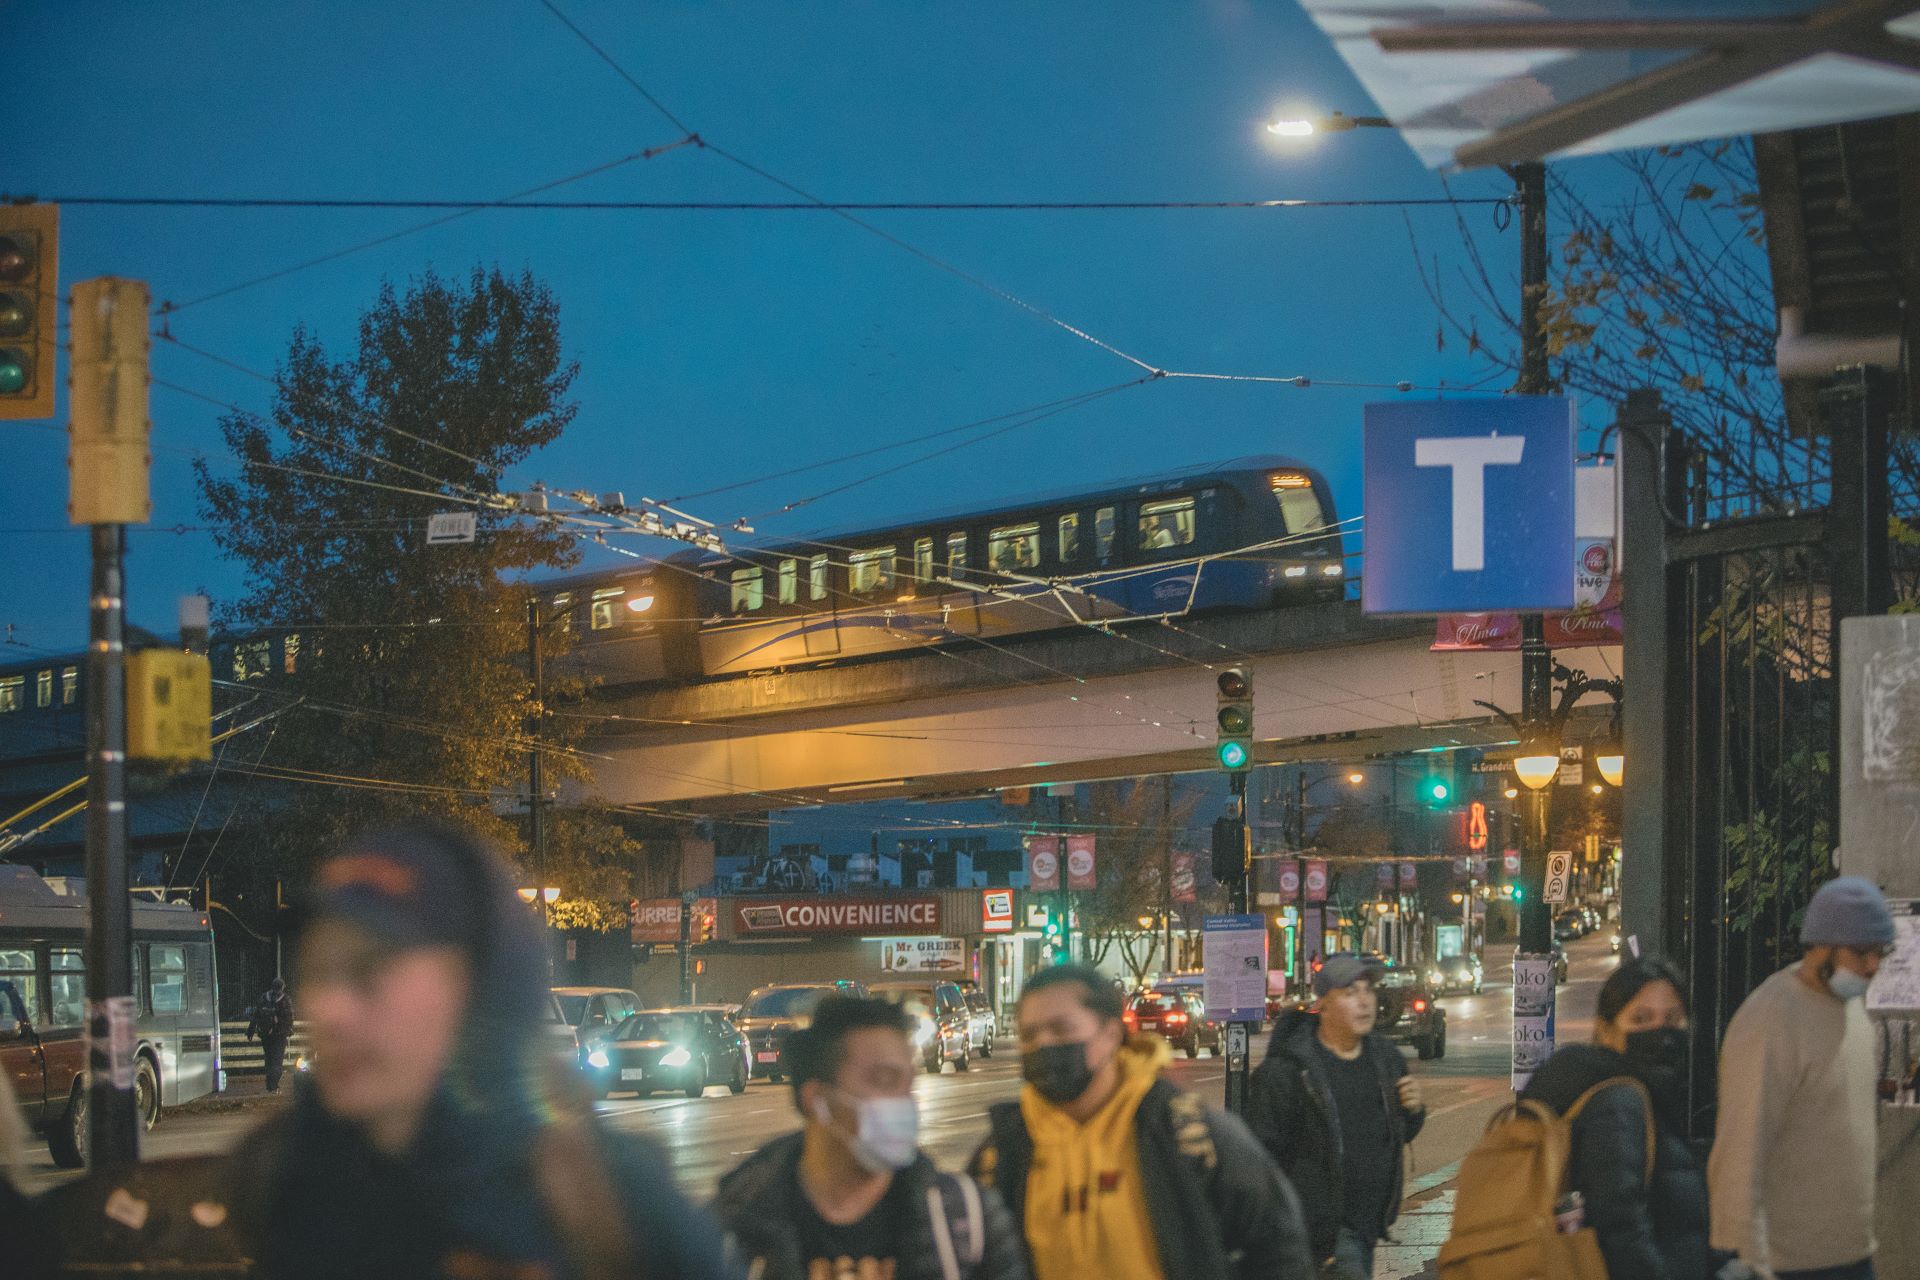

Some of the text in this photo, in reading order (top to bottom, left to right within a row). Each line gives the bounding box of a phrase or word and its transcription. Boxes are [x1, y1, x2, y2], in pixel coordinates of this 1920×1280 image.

[1415, 433, 1525, 571] T
[1577, 574, 1602, 588] ive
[786, 904, 935, 926] CONVENIENCE
[896, 941, 961, 952] Mr. GREEK
[1515, 968, 1545, 985] oko
[1514, 1025, 1544, 1041] oko
